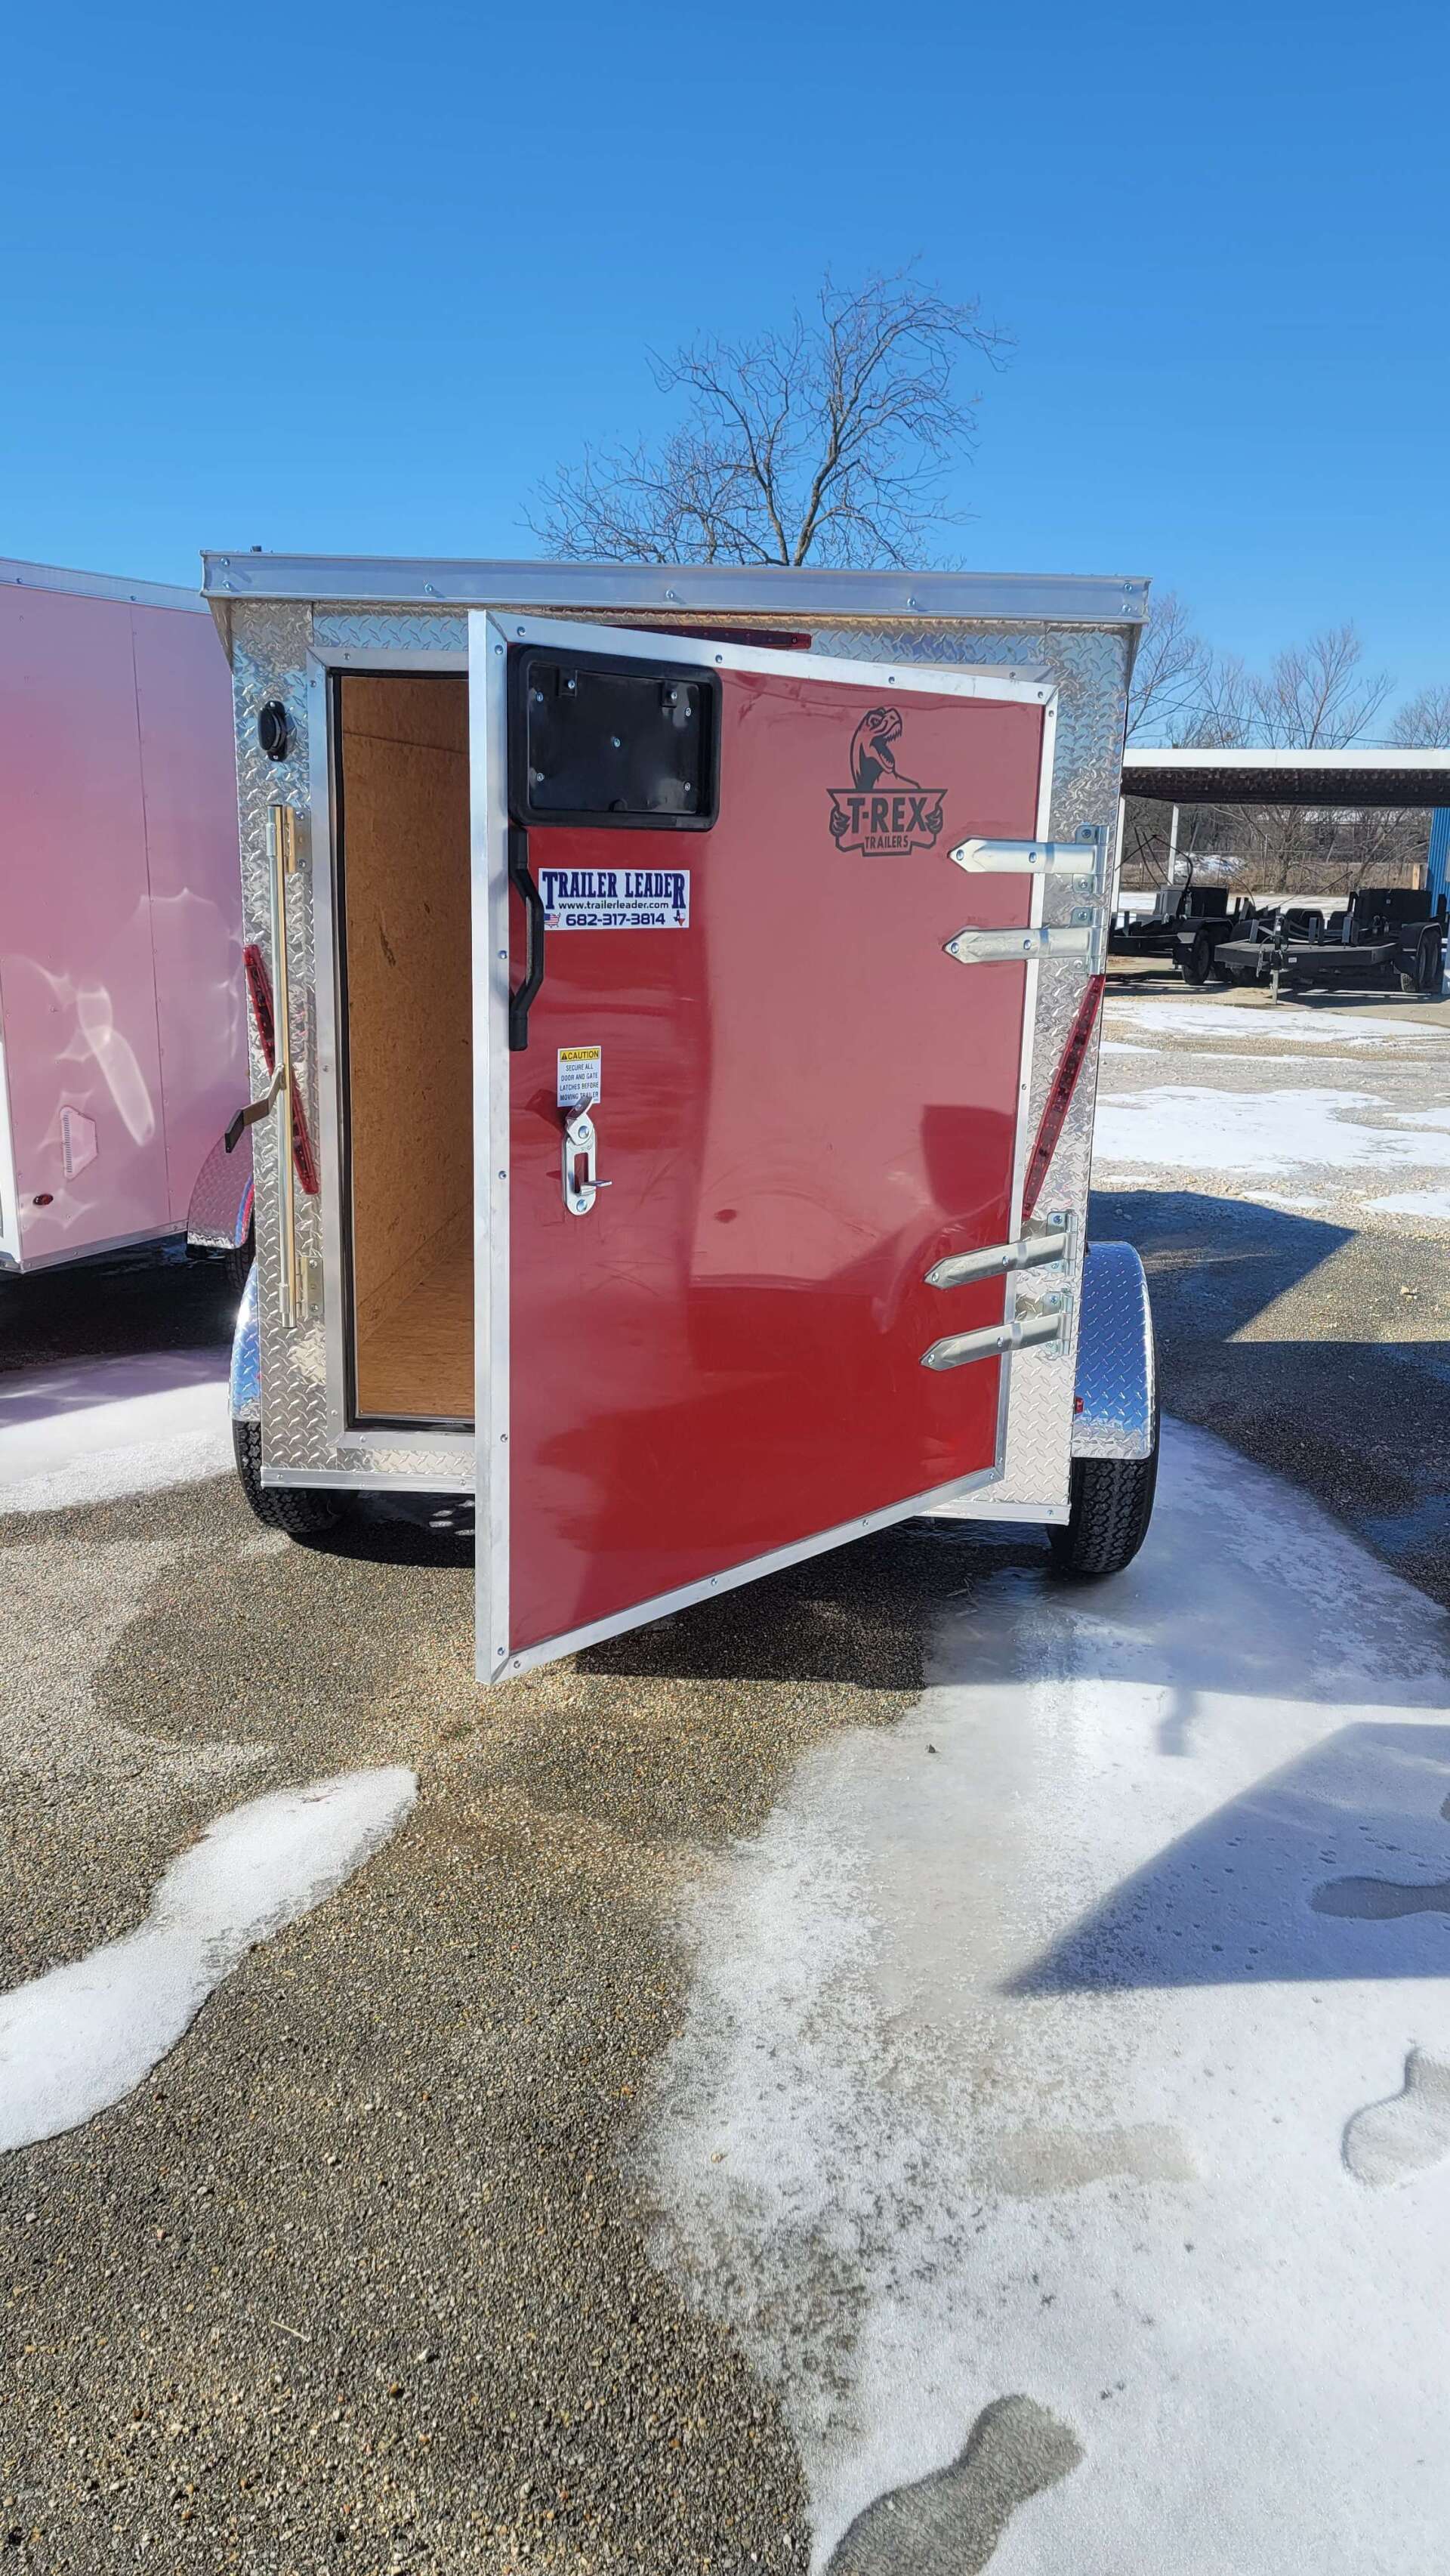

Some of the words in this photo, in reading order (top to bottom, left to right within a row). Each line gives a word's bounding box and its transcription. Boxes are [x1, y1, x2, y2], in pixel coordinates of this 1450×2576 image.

[847, 797, 927, 833] T-REX
[865, 836, 909, 849] TRAILERS
[542, 871, 618, 910] TRAILER
[625, 872, 686, 909] LEADER
[558, 900, 669, 910] www.trailerleader.com
[566, 913, 665, 926] 682-317-3814
[568, 1051, 599, 1059] CAUTION
